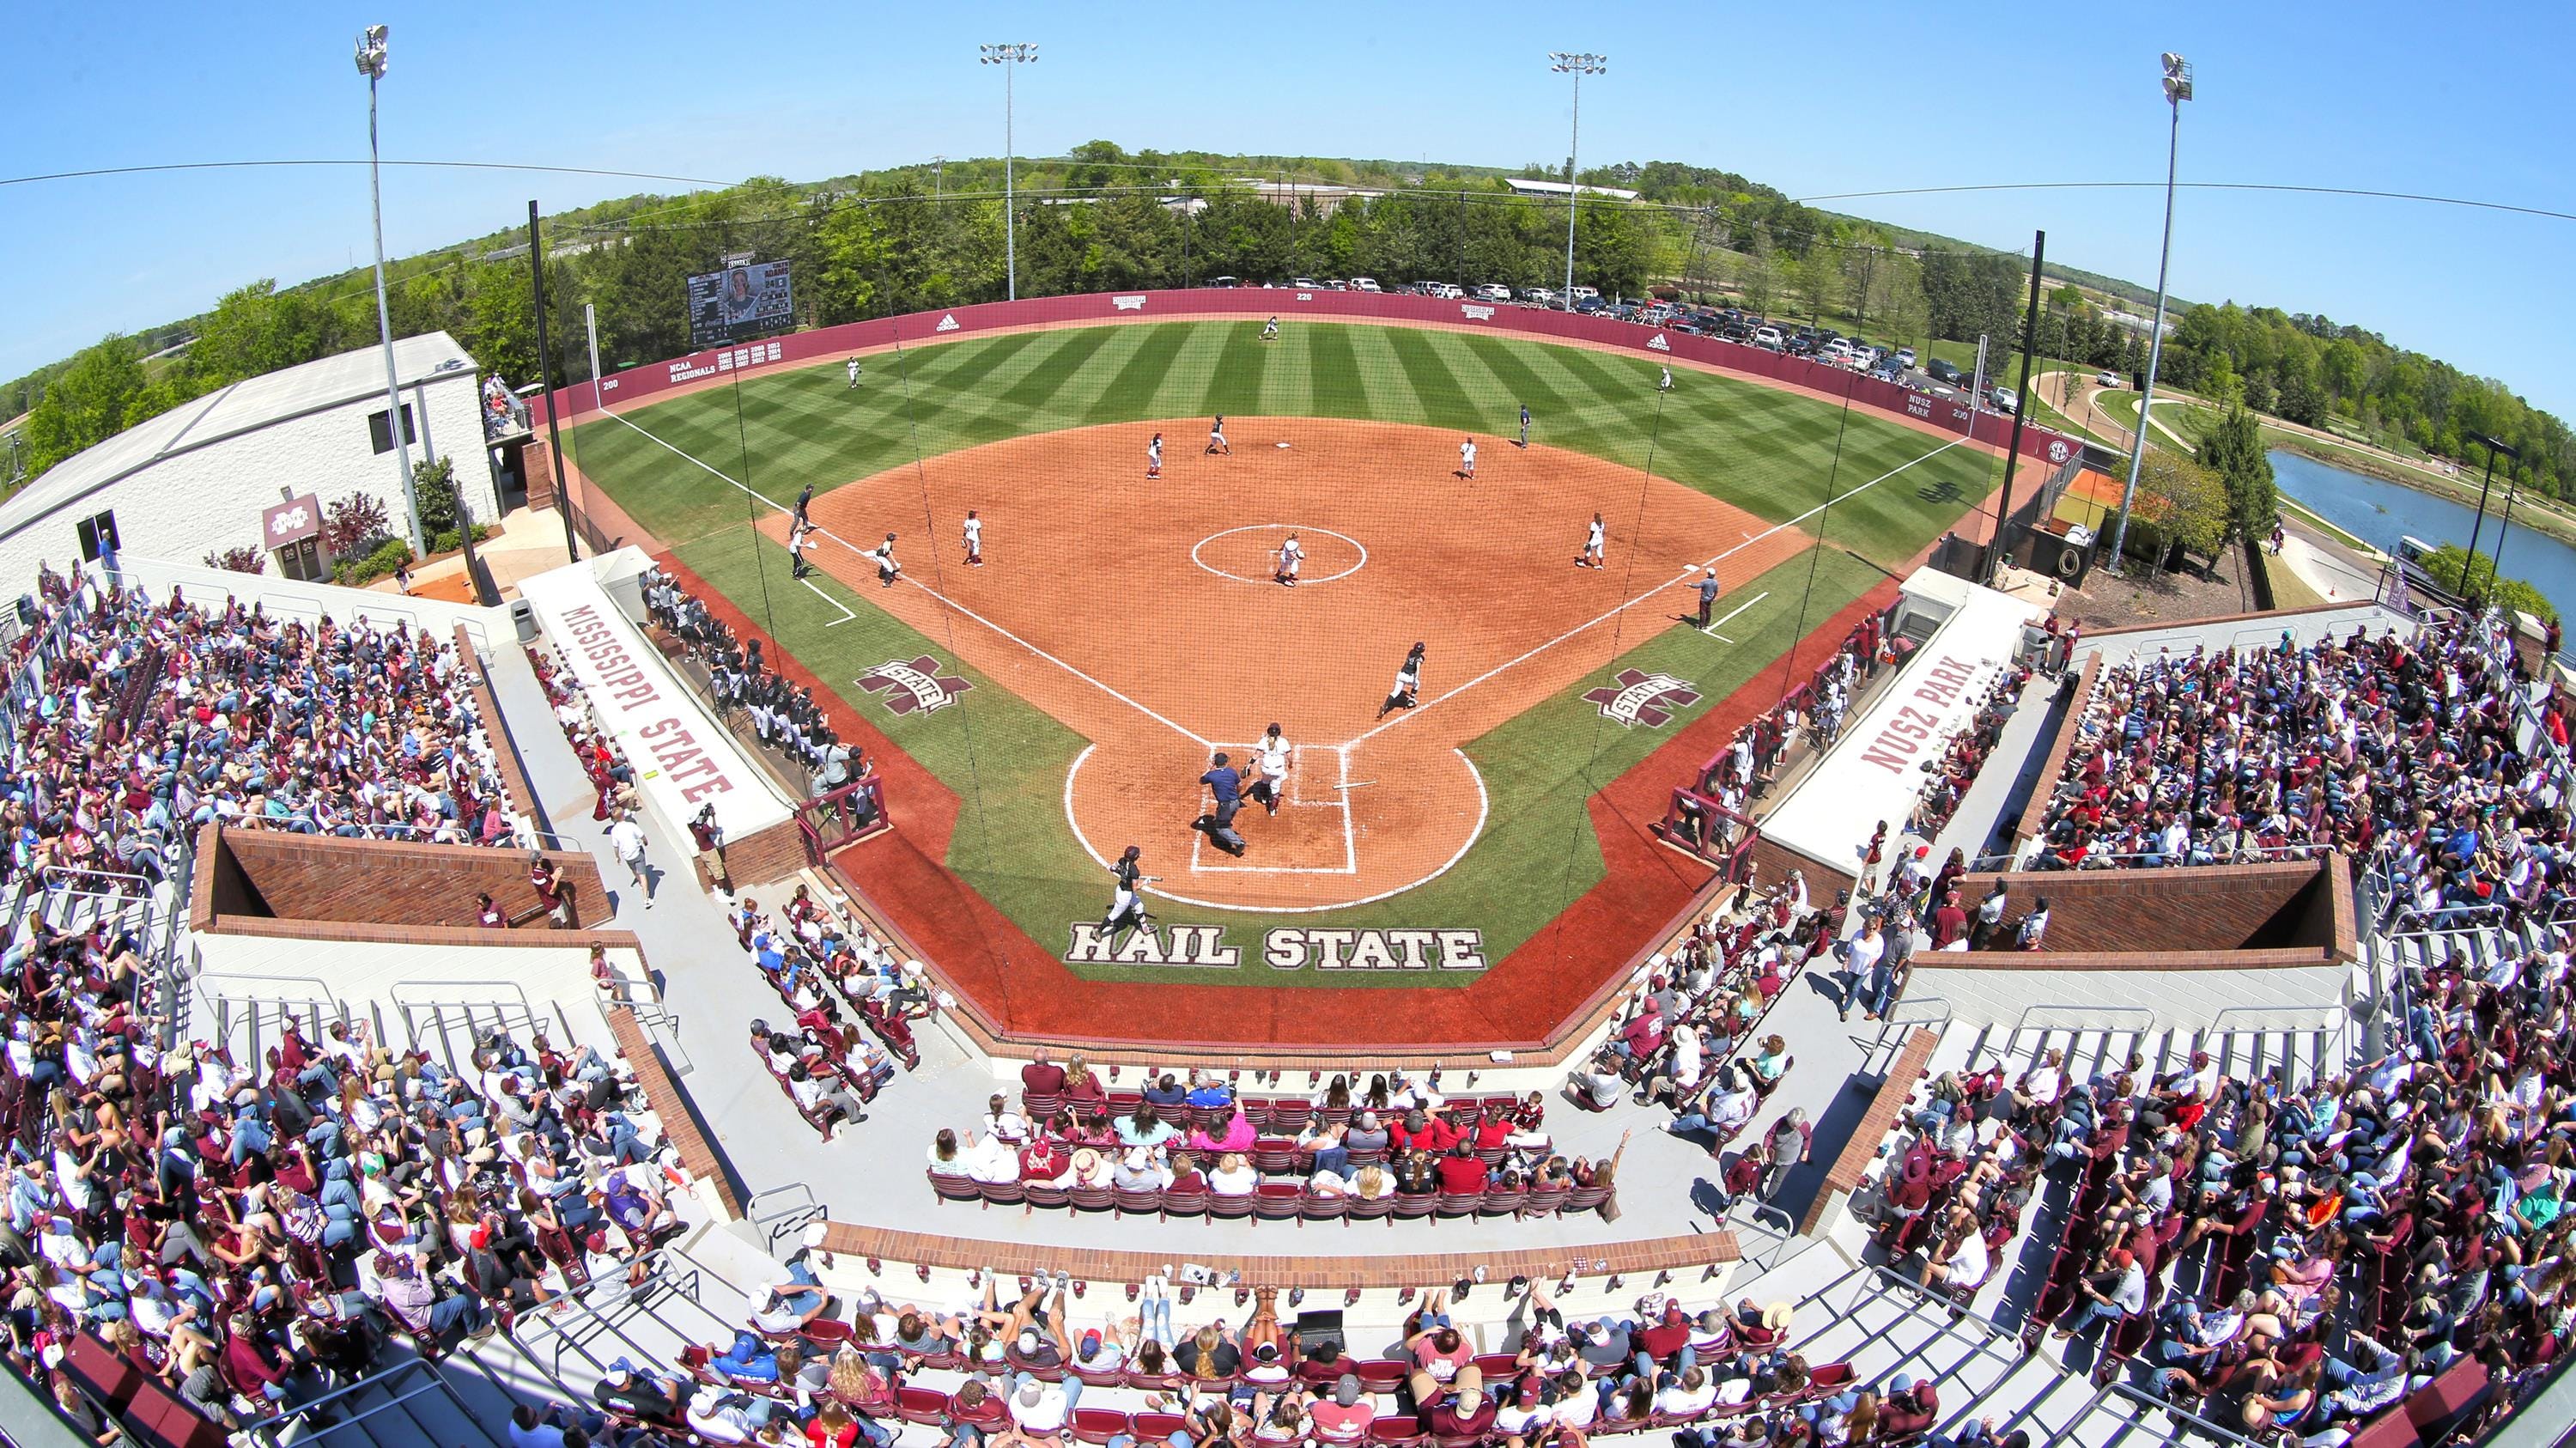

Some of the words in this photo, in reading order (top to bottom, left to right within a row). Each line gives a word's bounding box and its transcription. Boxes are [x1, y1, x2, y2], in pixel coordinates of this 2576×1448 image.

[765, 279, 775, 289] 24
[936, 323, 960, 332] adidas
[1646, 342, 1670, 351] adidas
[669, 361, 692, 374] NCAA
[671, 365, 715, 383] REGIONALS
[603, 379, 618, 391] 200
[1909, 394, 1931, 408] NUSZ
[1907, 405, 1929, 417] PARK
[1953, 409, 1968, 420] 200
[2050, 441, 2068, 461] SEC
[887, 668, 940, 703] STATE
[561, 604, 660, 712] MISSISSIPPI
[639, 717, 734, 804] STATE
[1616, 681, 1670, 714] STATE
[1861, 706, 1940, 775] NUSZ
[1913, 655, 1976, 709] PARK
[1066, 923, 1241, 966] HAIL
[1264, 927, 1486, 970] STATE
